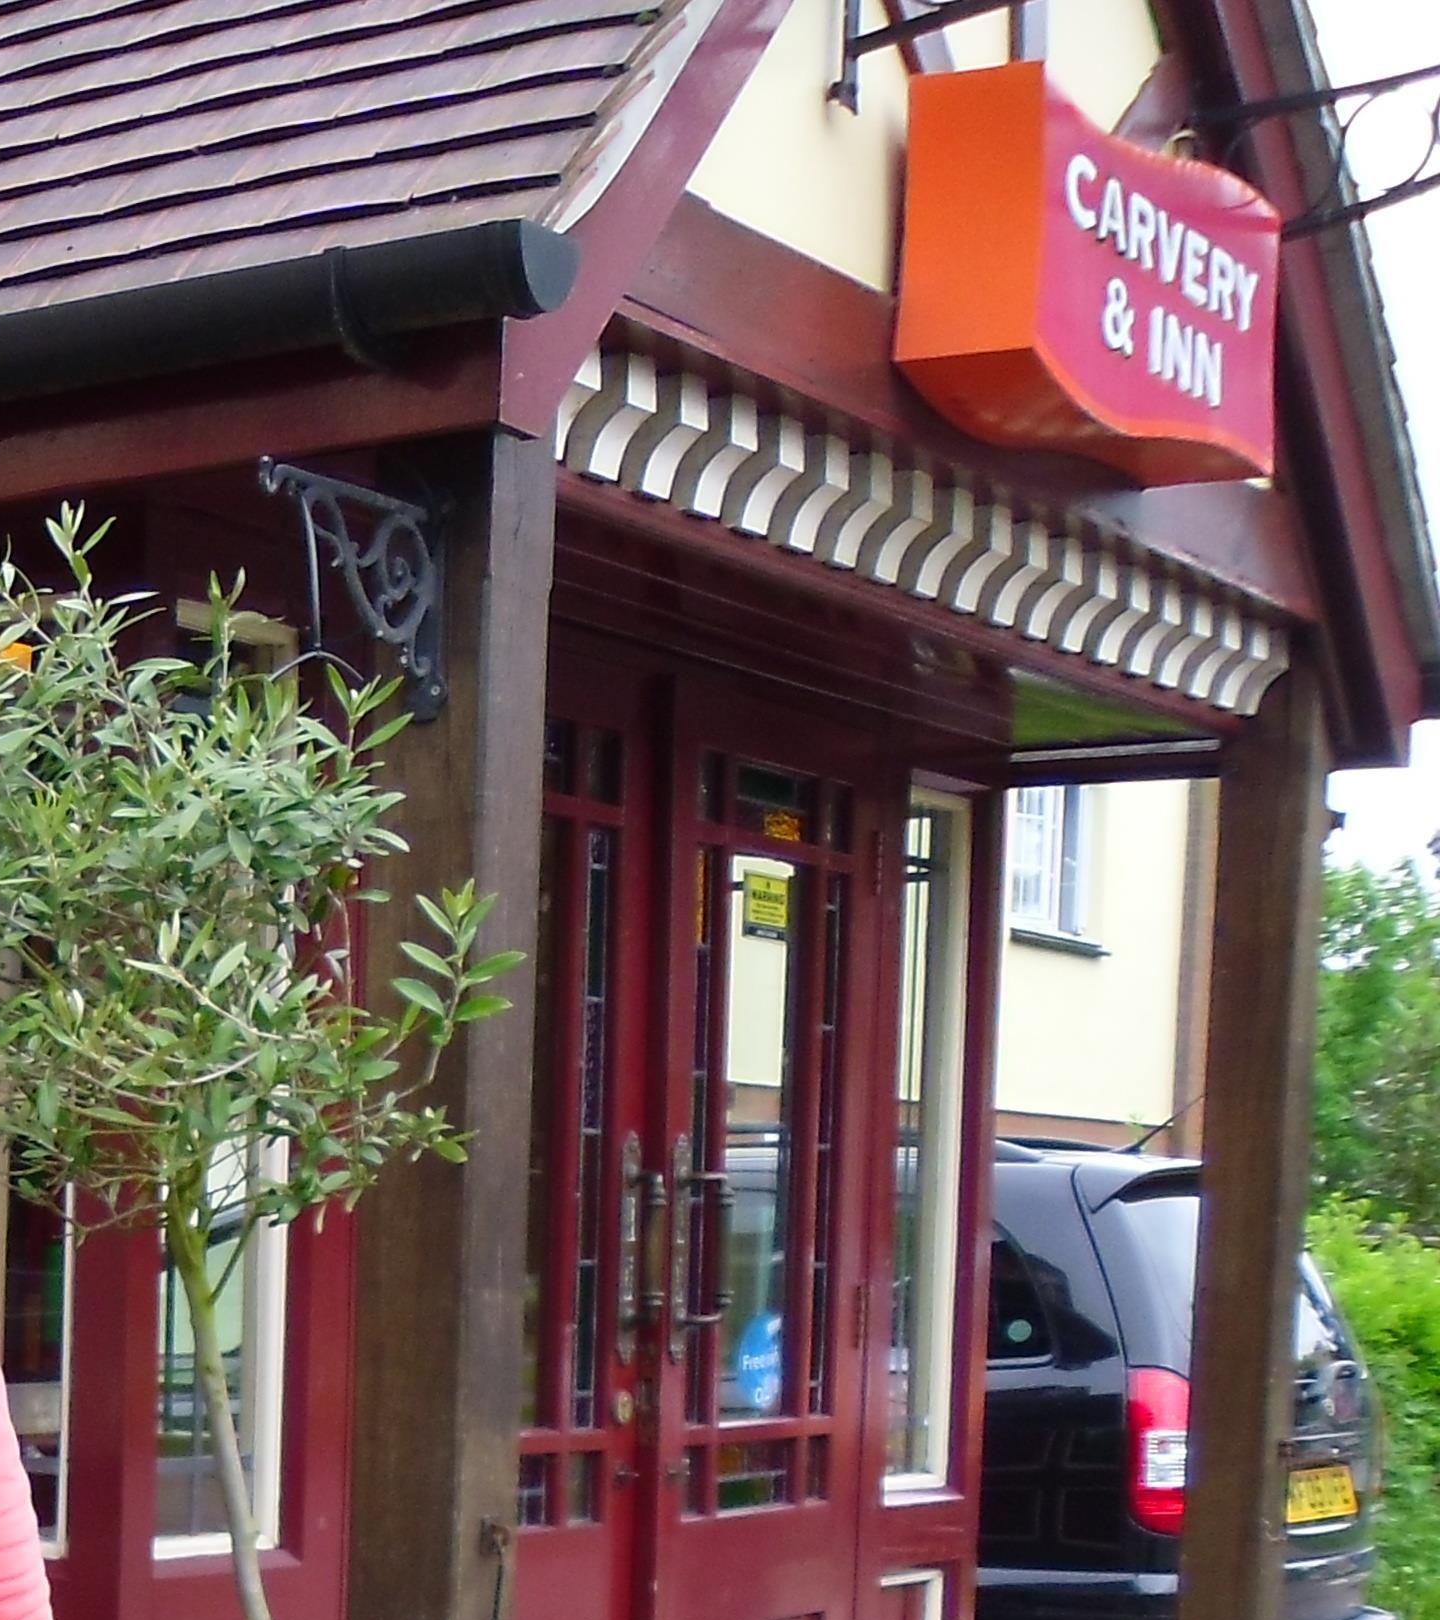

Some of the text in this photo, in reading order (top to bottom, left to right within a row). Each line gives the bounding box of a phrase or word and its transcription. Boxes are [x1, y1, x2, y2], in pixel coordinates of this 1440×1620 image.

[1065, 154, 1258, 331] CARVERY
[1103, 278, 1223, 407] & INN
